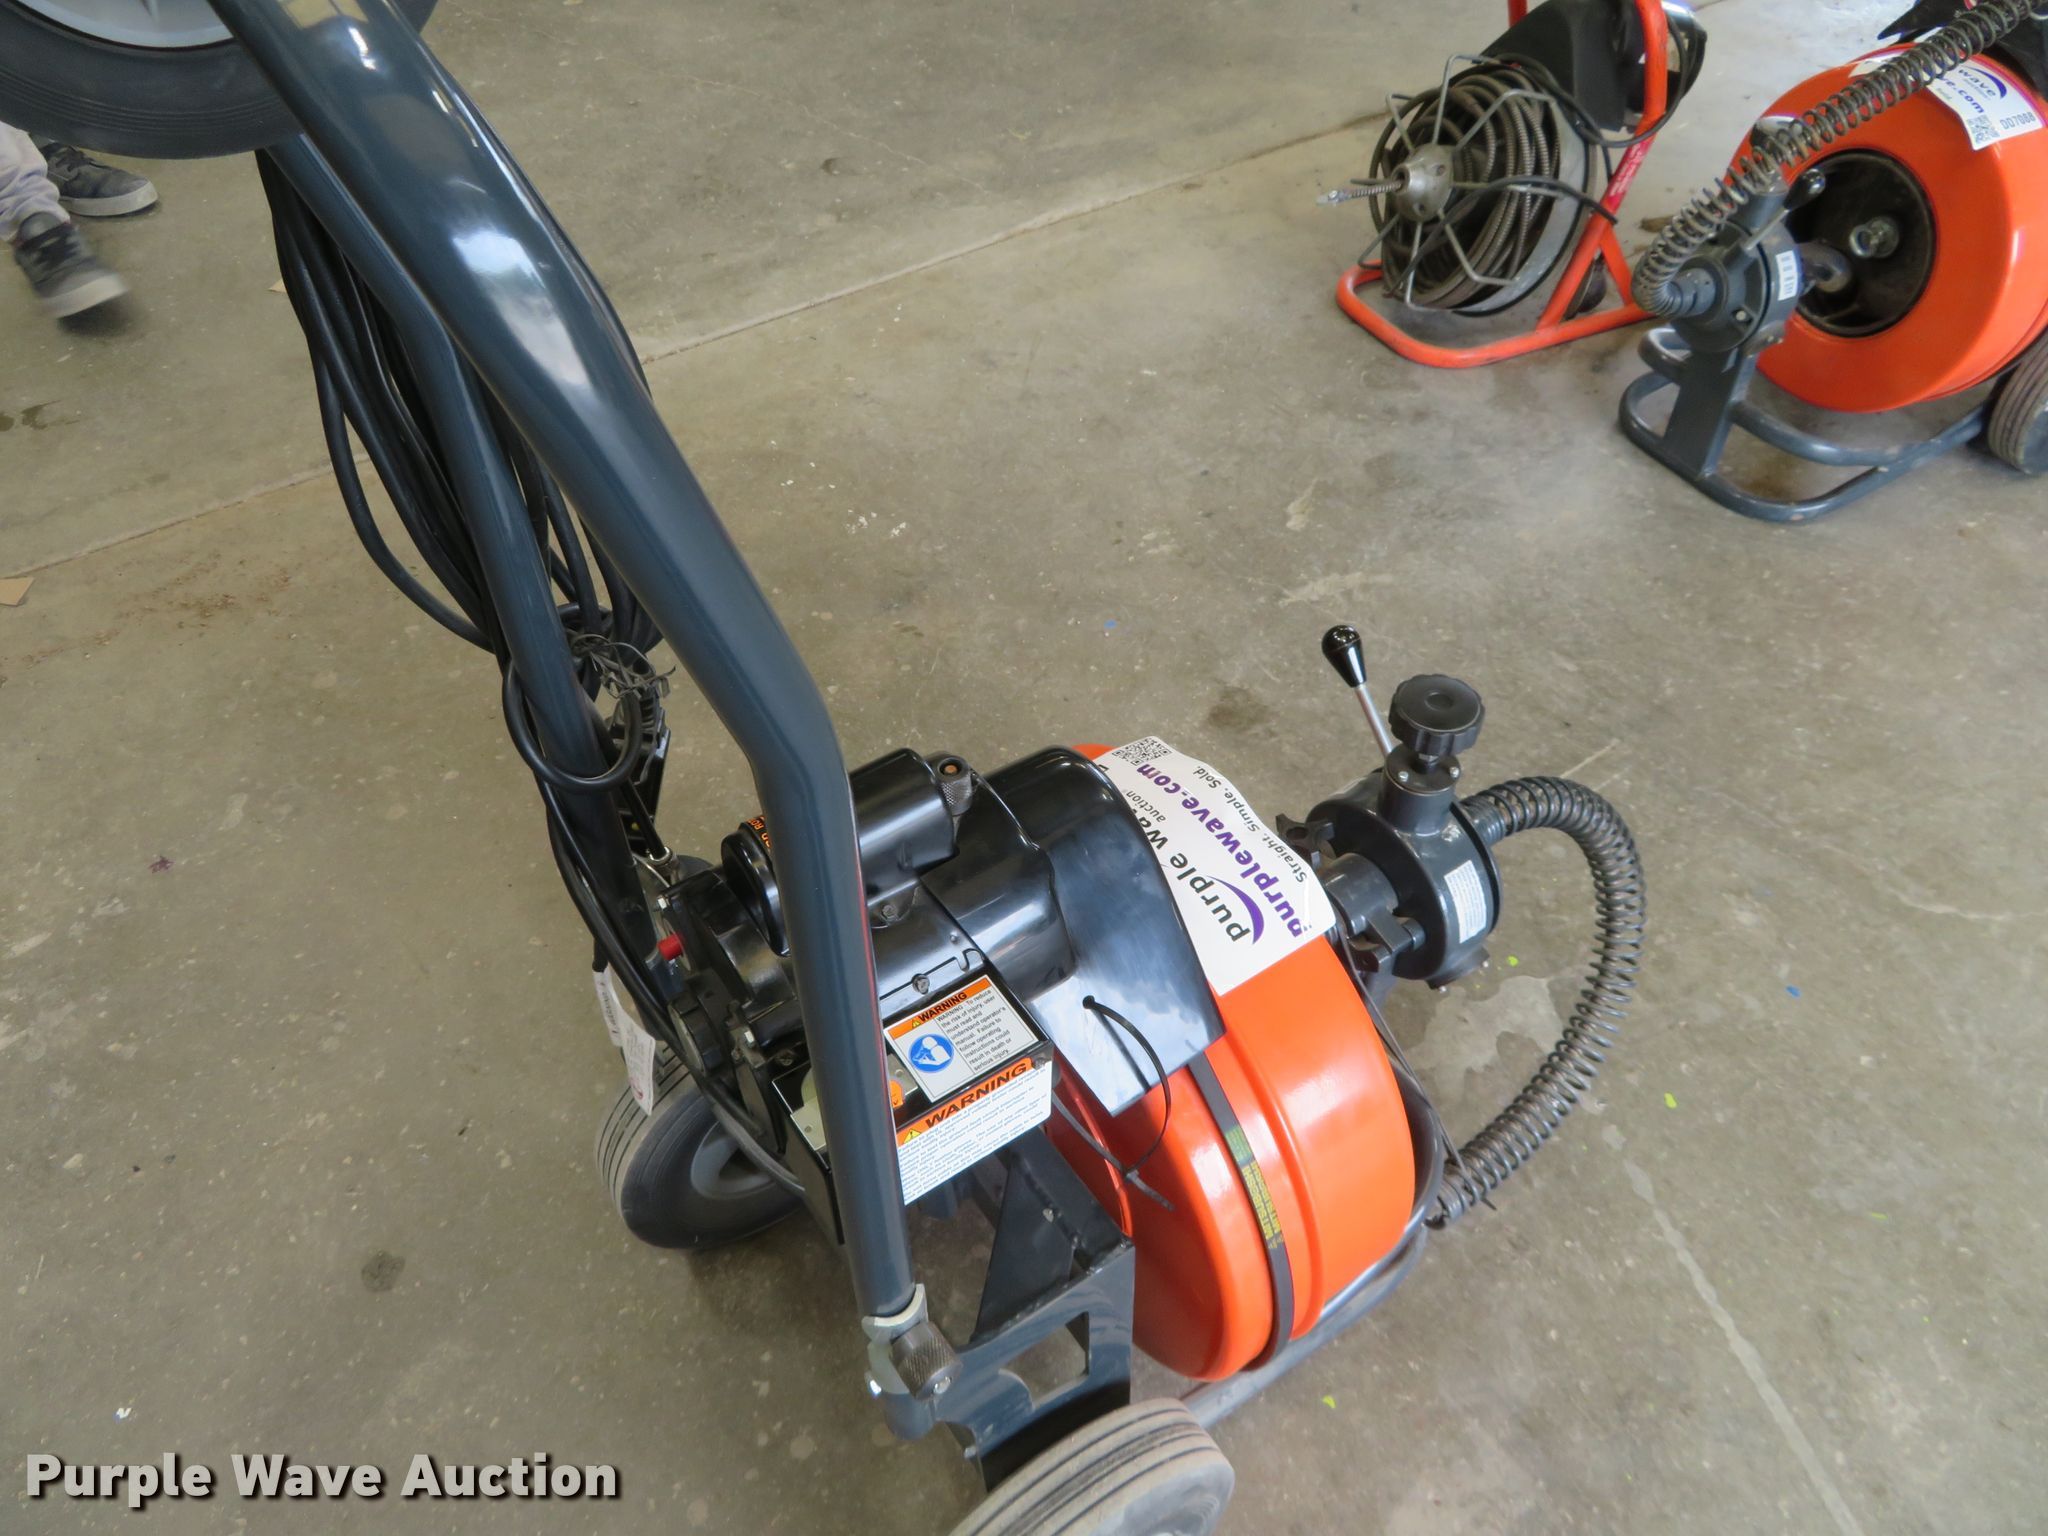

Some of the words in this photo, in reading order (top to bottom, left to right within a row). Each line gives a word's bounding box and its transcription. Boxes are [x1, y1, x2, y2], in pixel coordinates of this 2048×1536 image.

[1957, 68, 1997, 97] wave
[1192, 765, 1222, 789] Sold.
[1127, 790, 1167, 823] auction
[1223, 787, 1261, 833] Simple.
[1136, 763, 1308, 938] purplewave.com
[1261, 833, 1308, 883] Straight.
[1169, 853, 1250, 942] purple
[917, 991, 968, 1022] WARNING
[936, 1004, 963, 1021] WARNING
[972, 989, 991, 1001] reduce
[950, 1014, 961, 1022] risk
[966, 1002, 985, 1014] injury,
[945, 1023, 960, 1034] must
[959, 1016, 972, 1026] read
[971, 1011, 982, 1019] and
[949, 1021, 980, 1040] understand
[979, 1006, 1006, 1024] operator's
[954, 1032, 976, 1046] manual.
[976, 1021, 995, 1033] Failure
[959, 1040, 976, 1052] follow
[975, 1026, 1001, 1043] operating
[963, 1038, 995, 1058] instructions
[994, 1029, 1010, 1041] could
[968, 1052, 985, 1065] result
[989, 1040, 1005, 1052] death
[972, 1056, 994, 1071] serious
[925, 1062, 1028, 1129] WARNING
